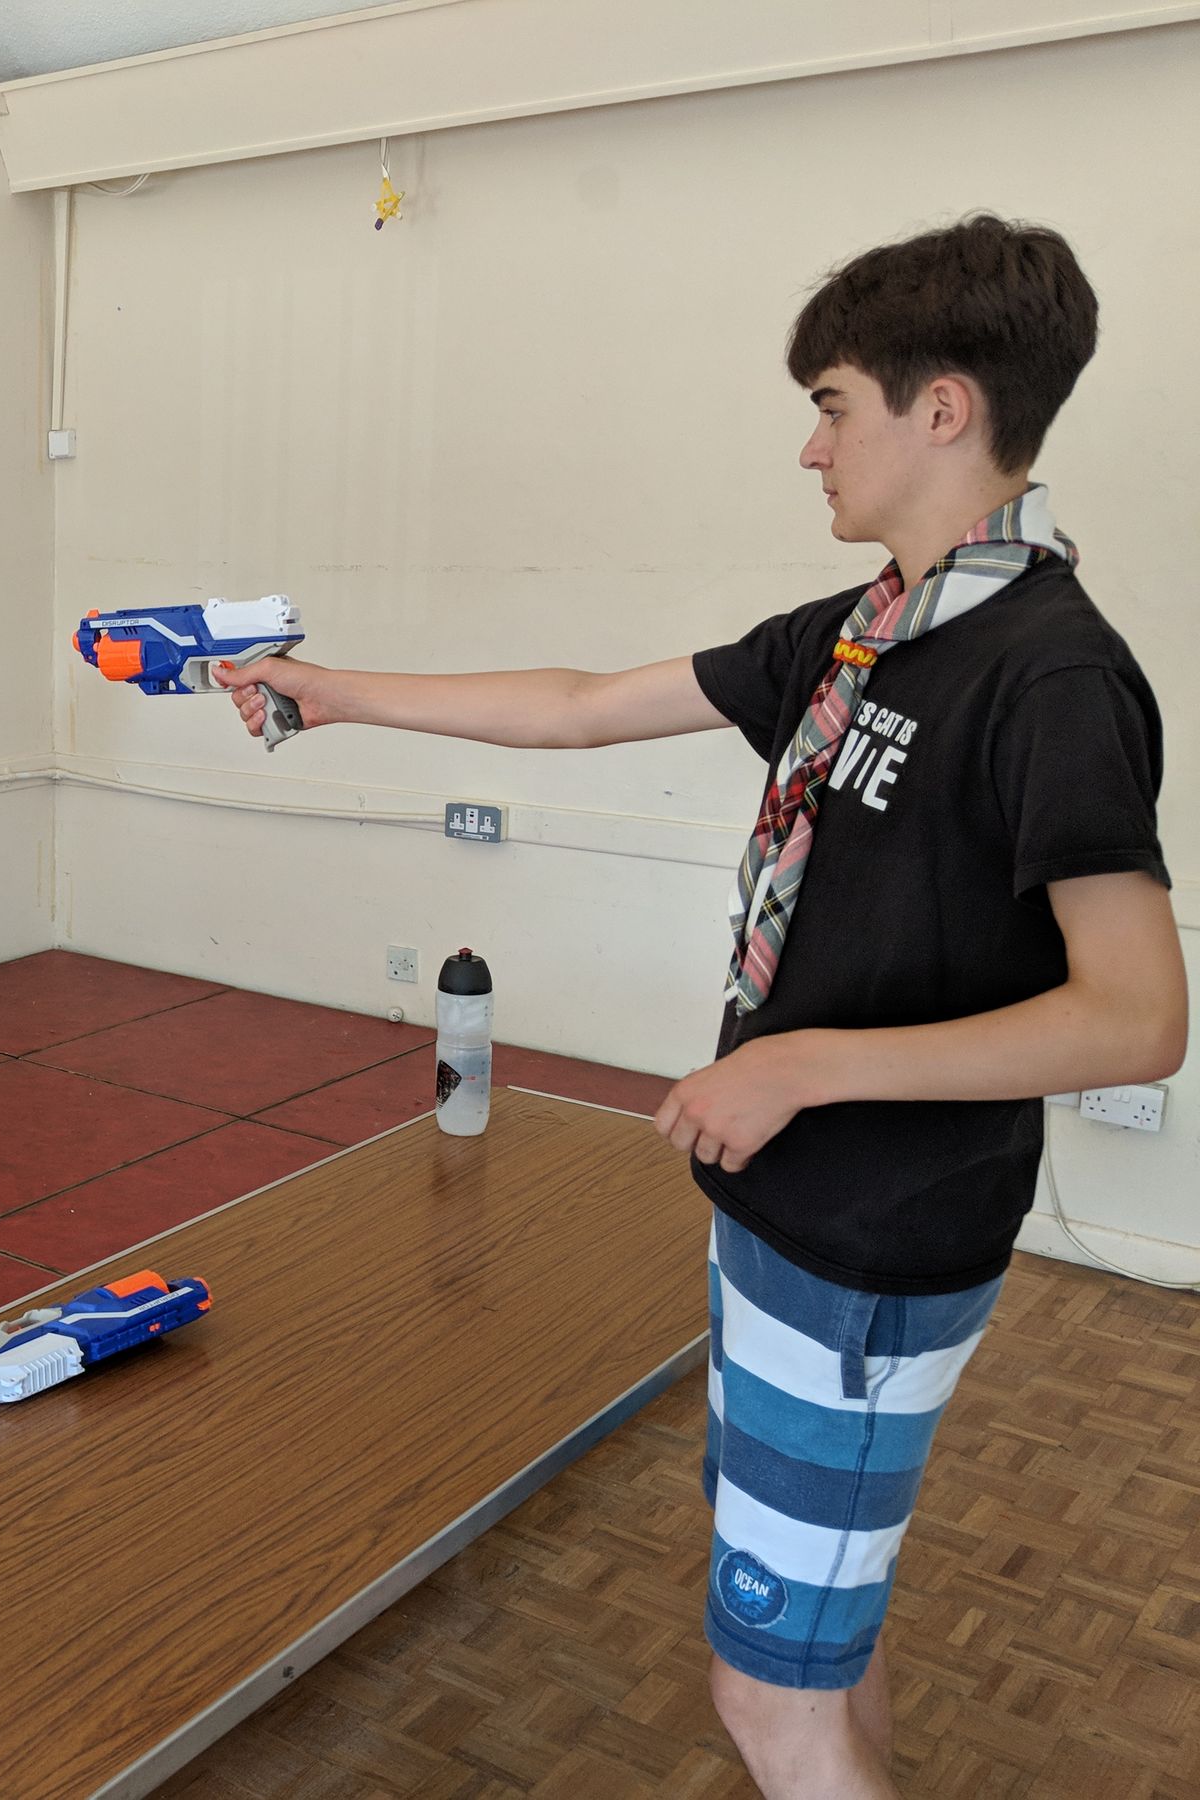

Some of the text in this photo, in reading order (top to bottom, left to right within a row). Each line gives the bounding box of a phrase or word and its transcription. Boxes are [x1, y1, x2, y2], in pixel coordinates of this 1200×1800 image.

[871, 707, 904, 738] CAT
[894, 718, 918, 746] IS
[734, 1568, 769, 1597] OCEAN
